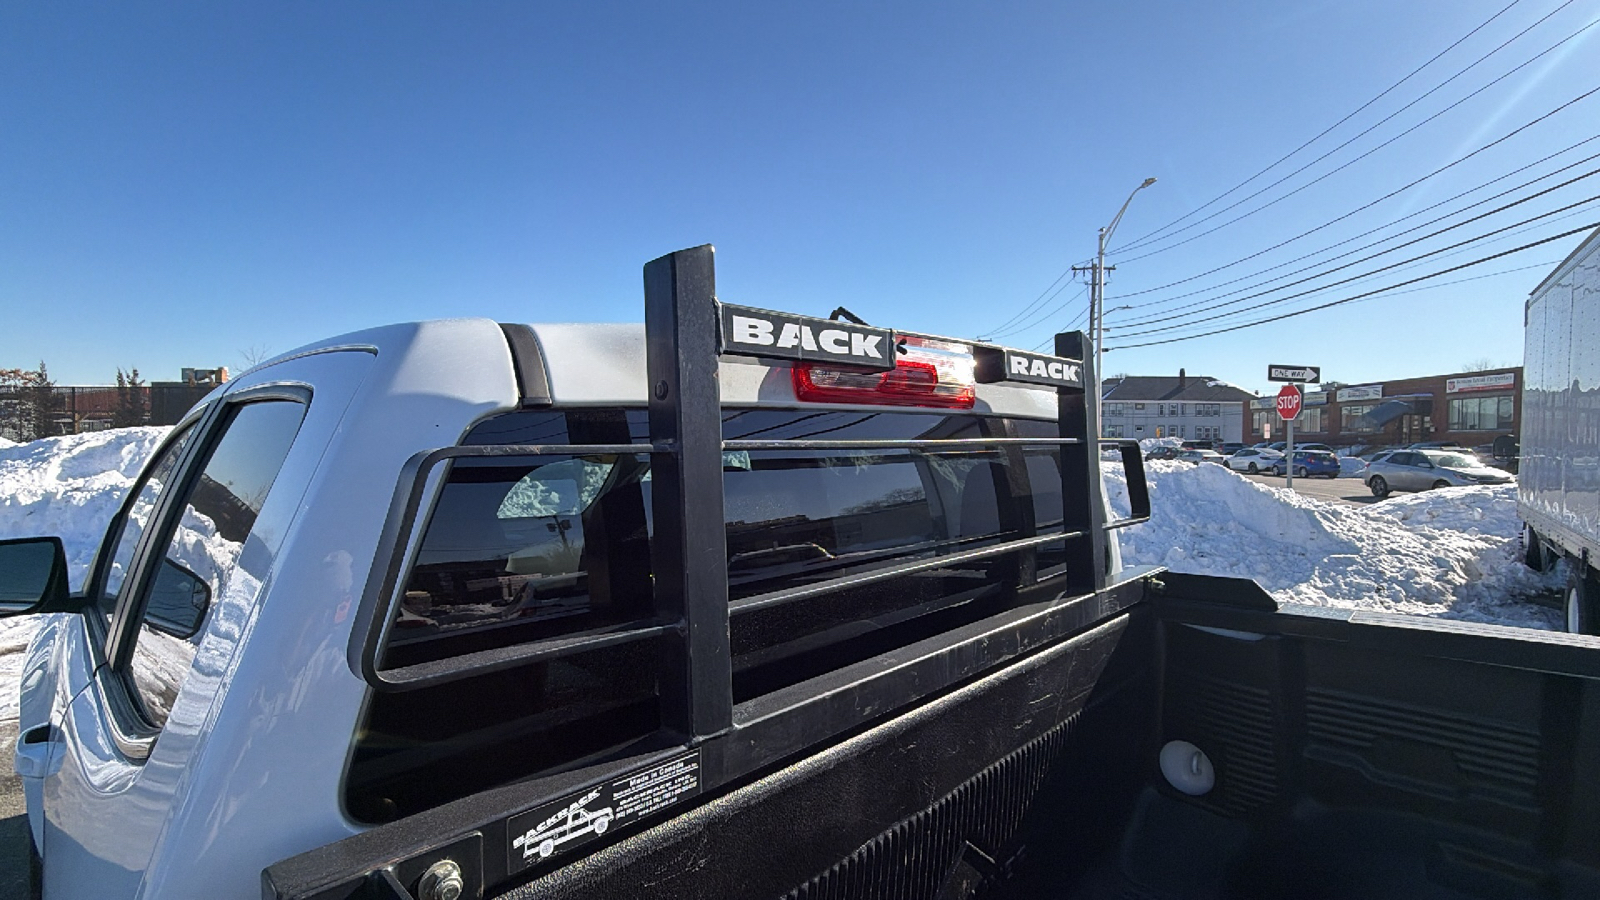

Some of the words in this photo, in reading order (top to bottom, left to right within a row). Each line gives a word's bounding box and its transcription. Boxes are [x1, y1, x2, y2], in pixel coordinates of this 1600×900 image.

[732, 315, 883, 358] BACK
[1009, 355, 1080, 382] RACK
[1274, 369, 1289, 377] ONE
[1278, 395, 1299, 409] STOP
[629, 775, 649, 787] Made
[659, 762, 684, 775] Canada
[619, 781, 673, 806] BACKRACK
[513, 788, 602, 850] BACKRACK
